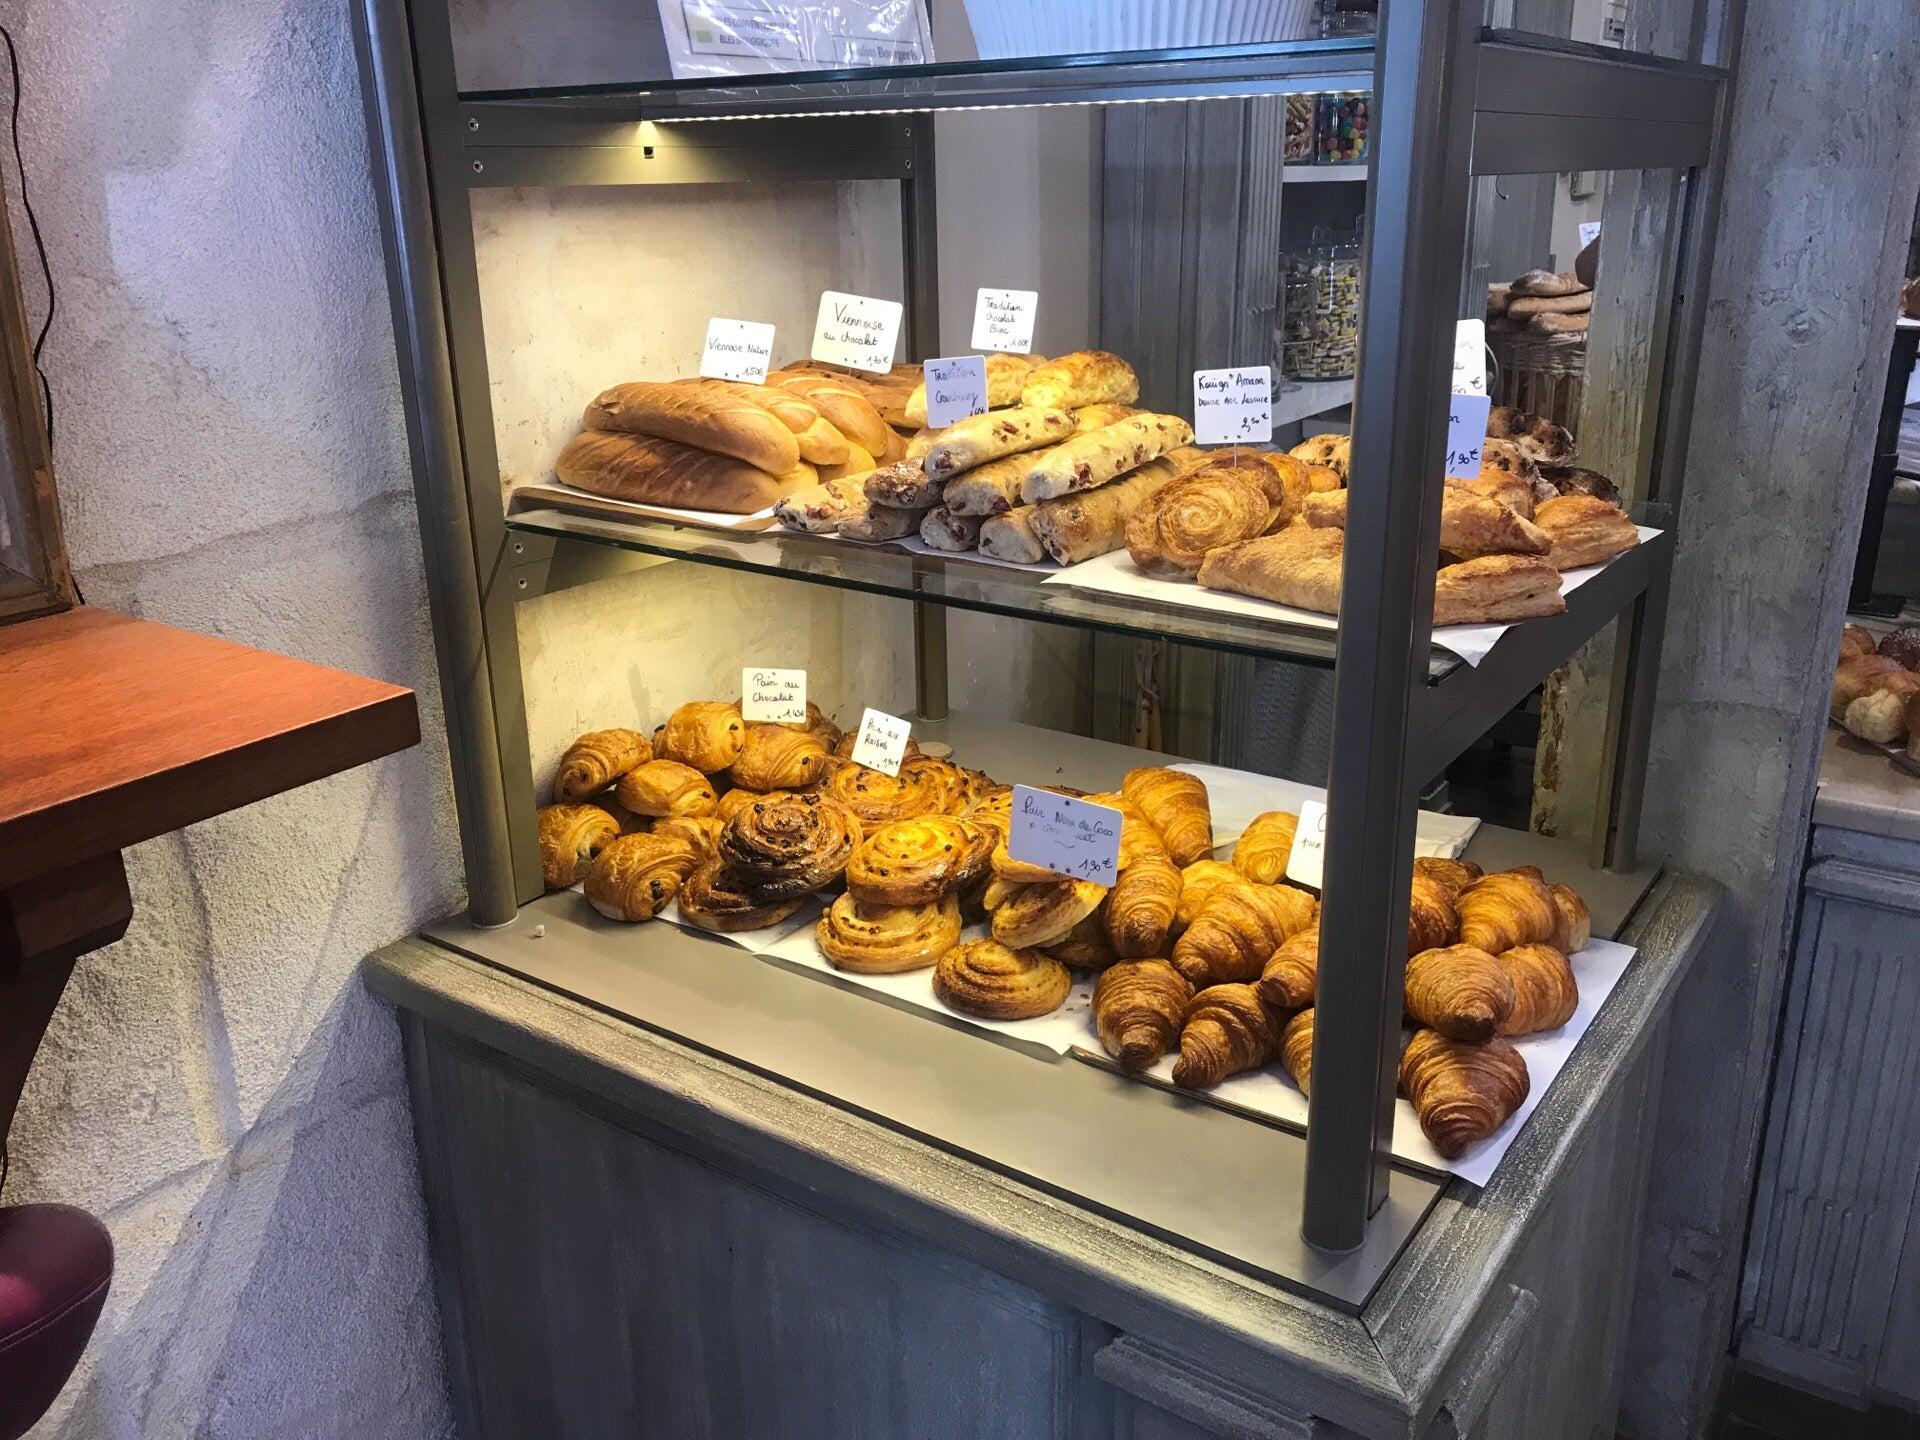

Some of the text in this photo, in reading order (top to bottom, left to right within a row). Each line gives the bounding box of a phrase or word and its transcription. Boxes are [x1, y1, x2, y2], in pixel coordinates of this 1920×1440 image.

[834, 301, 885, 332] Viennoise
[823, 331, 836, 341] au
[752, 672, 801, 689] Pain au
[752, 691, 795, 702] Chocolat
